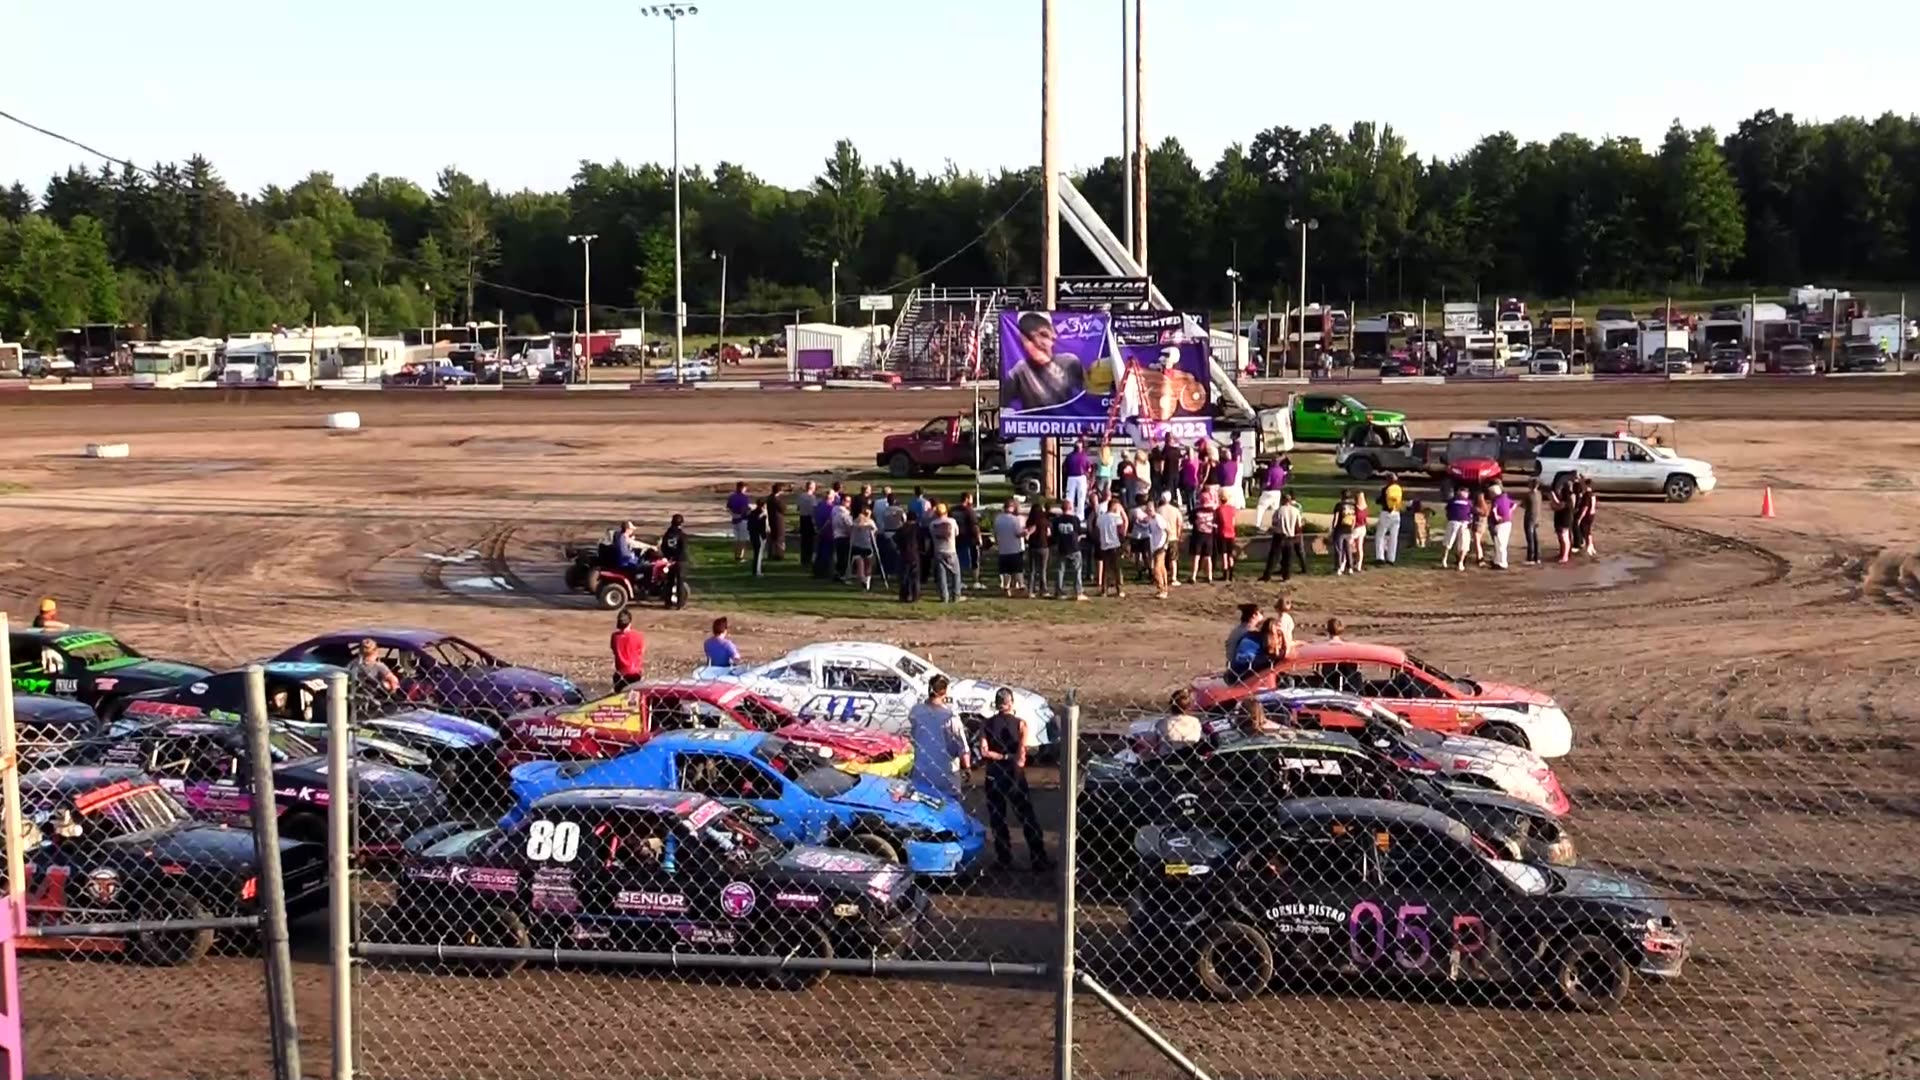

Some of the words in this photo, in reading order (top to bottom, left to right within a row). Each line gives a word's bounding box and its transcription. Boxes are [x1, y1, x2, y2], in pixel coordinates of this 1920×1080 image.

[1004, 421, 1081, 434] MEMORIAL
[1162, 422, 1207, 437] 2023
[526, 820, 580, 862] 80
[451, 866, 468, 884] K
[618, 891, 685, 906] SENIOR
[1266, 903, 1306, 920] CORNER
[1308, 904, 1346, 922] BISTRO
[1350, 902, 1430, 970] 05
